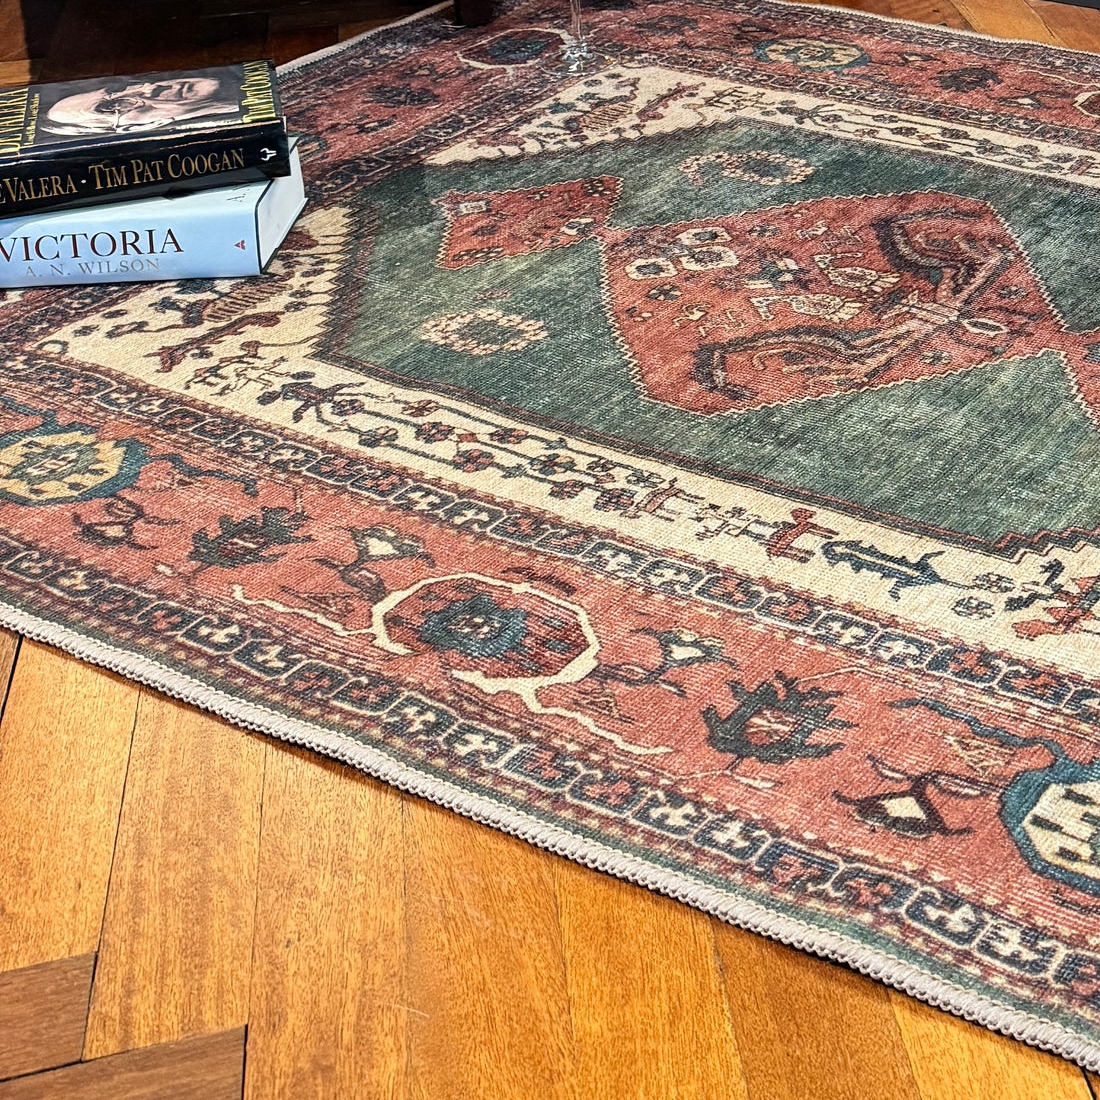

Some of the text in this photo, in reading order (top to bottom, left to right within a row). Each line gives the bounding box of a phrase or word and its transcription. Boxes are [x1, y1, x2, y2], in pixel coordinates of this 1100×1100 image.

[3, 174, 79, 203] VALERA
[88, 163, 129, 190] TIM
[131, 159, 164, 184] PAT
[167, 148, 245, 179] COOGAN
[0, 227, 185, 263] VICTORIA
[25, 257, 161, 278] A. N. WILSON
